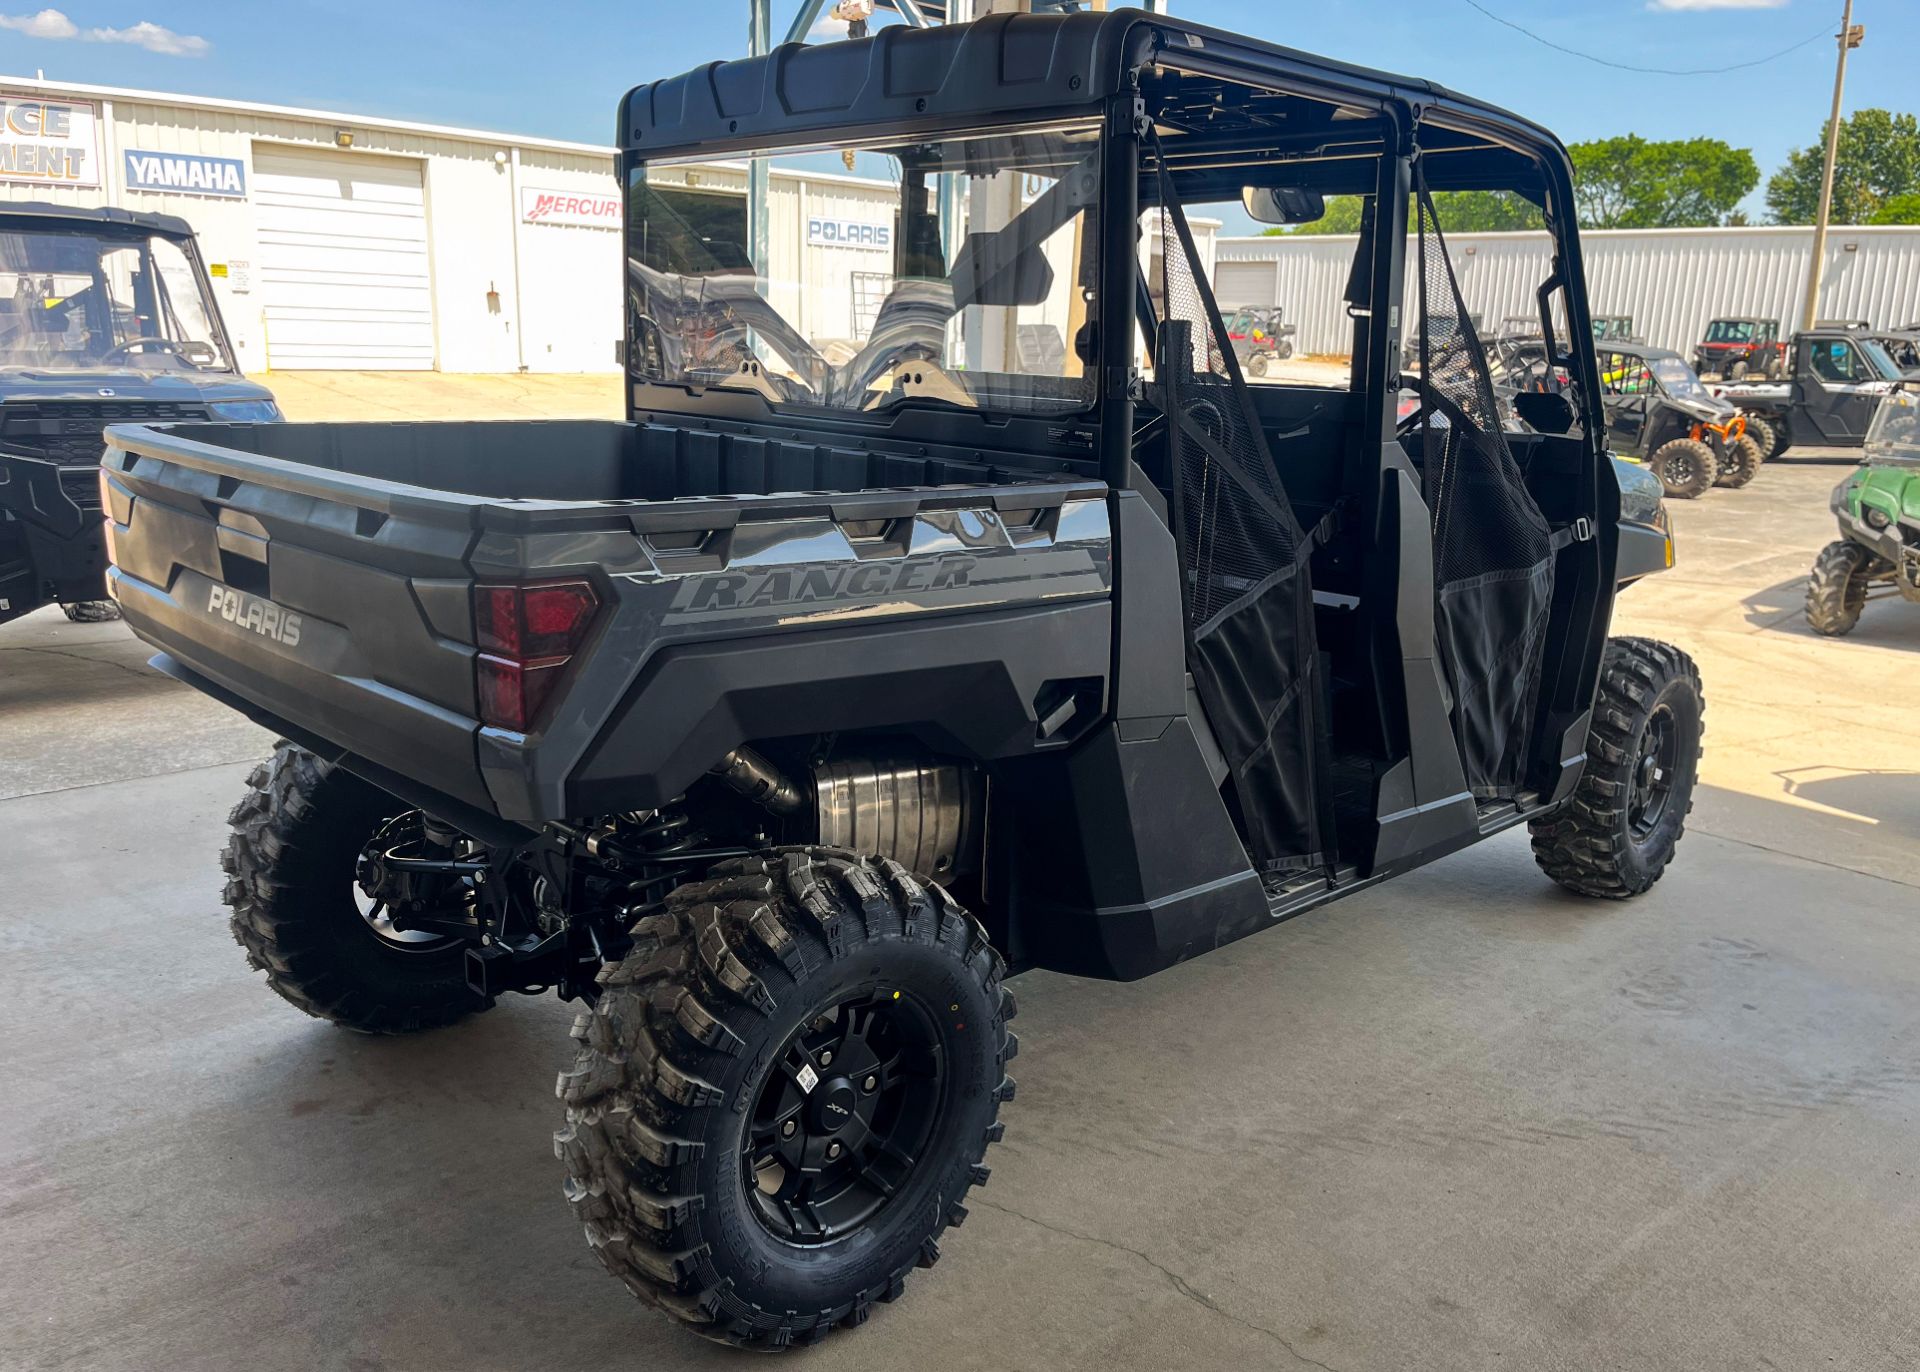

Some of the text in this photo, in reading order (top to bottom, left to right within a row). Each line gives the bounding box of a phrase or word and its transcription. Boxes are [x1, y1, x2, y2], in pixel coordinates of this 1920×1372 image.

[0, 101, 71, 138] CE
[128, 155, 242, 192] YAMAHA
[527, 194, 623, 219] MERCUR
[808, 220, 889, 245] POLARIS
[684, 557, 977, 612] RANGER
[207, 584, 302, 647] POLARIS
